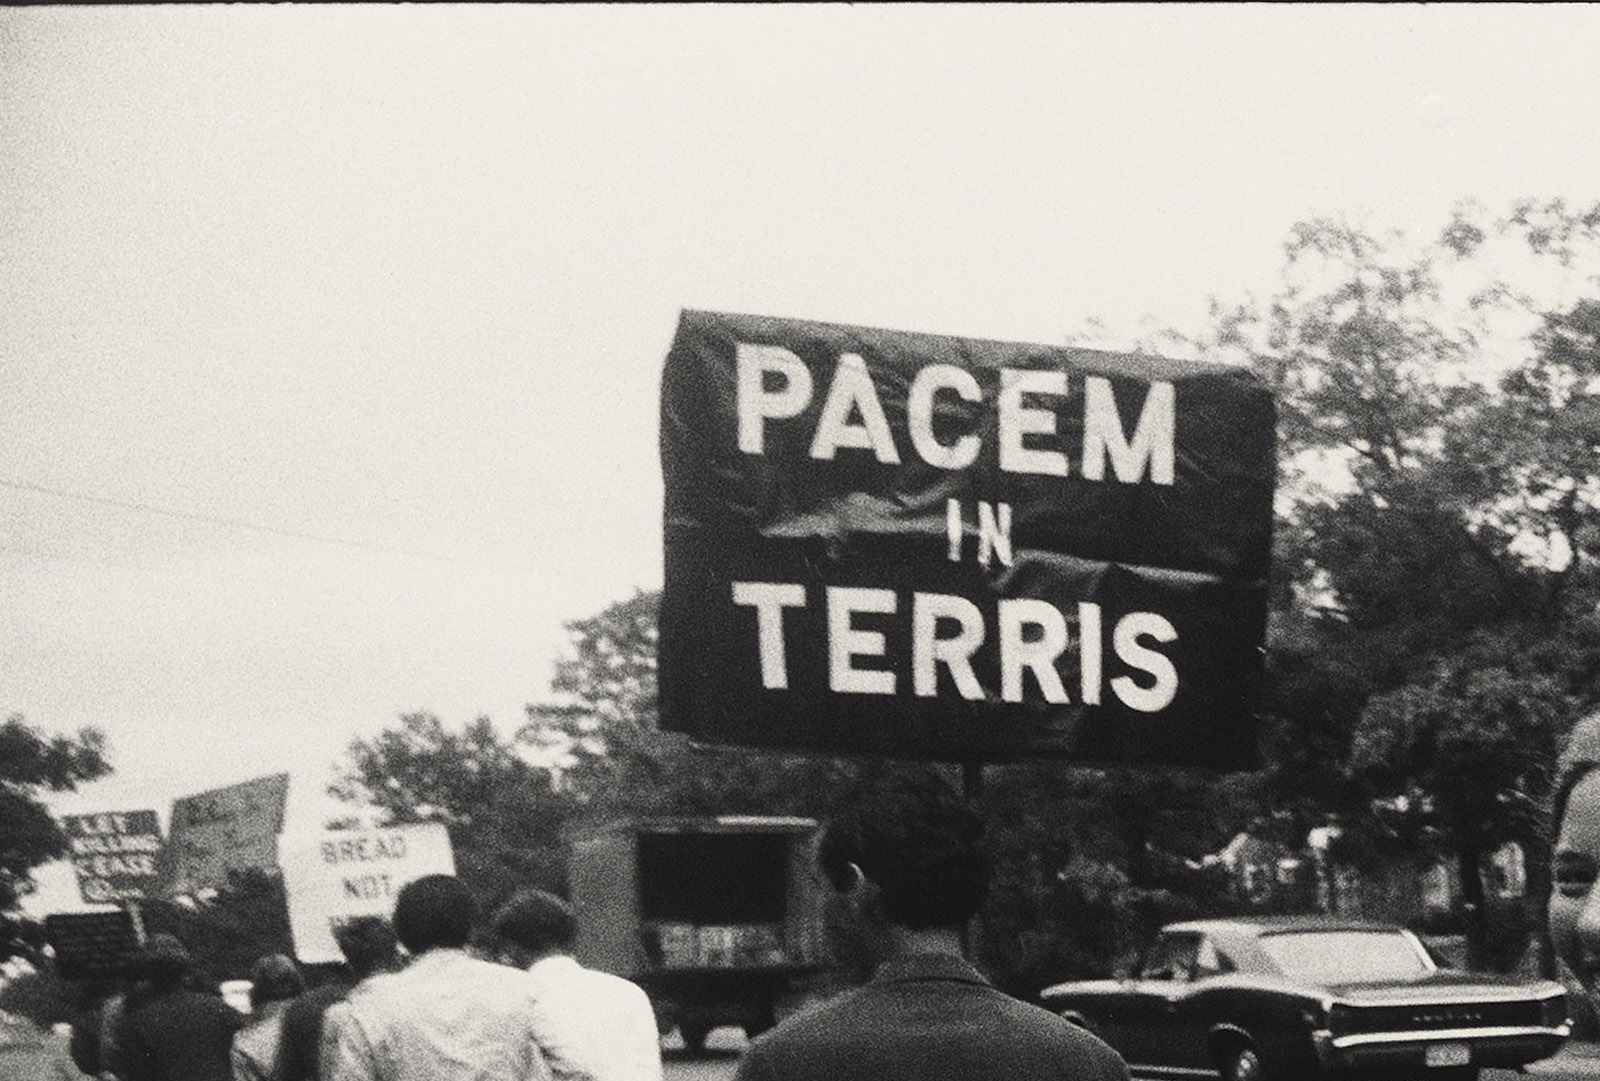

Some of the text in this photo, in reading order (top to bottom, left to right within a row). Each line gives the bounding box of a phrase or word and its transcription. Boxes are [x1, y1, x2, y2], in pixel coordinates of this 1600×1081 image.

[735, 342, 1177, 487] PACEM
[946, 497, 1013, 567] IN
[731, 580, 1180, 712] TERRIS
[320, 836, 406, 863] BREAD
